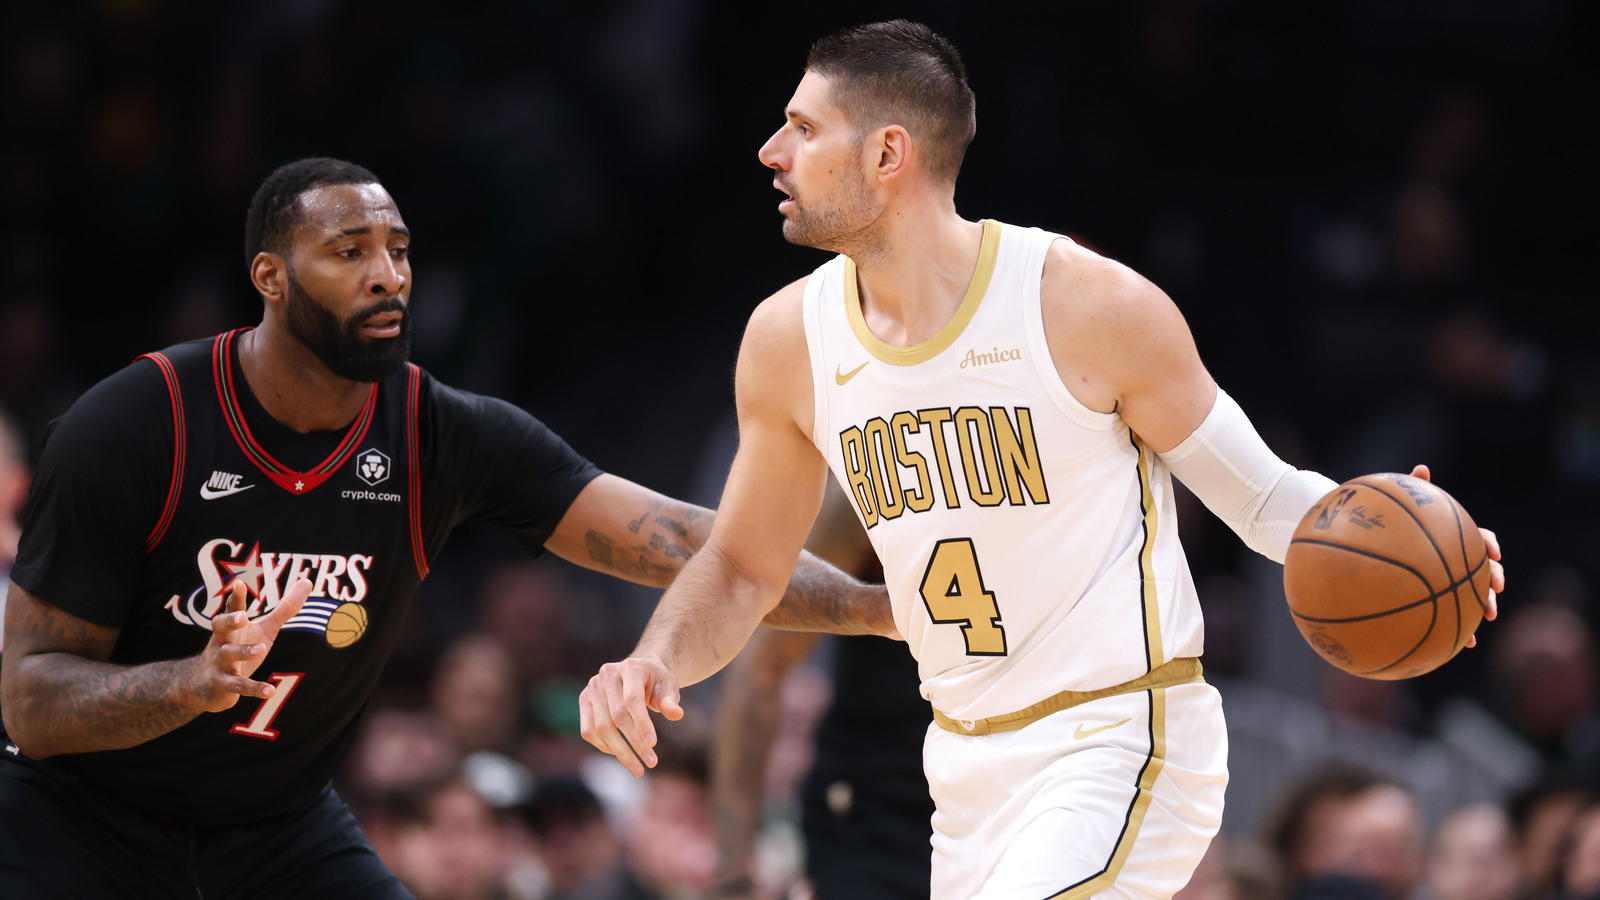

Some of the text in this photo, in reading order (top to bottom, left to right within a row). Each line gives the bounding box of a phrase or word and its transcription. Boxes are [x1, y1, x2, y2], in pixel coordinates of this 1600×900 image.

[959, 346, 1022, 370] Amica
[207, 470, 244, 490] NIKE
[839, 406, 1050, 530] BOSTON
[341, 490, 401, 503] crypto.com
[918, 537, 1007, 657] 4
[230, 672, 306, 741] 1
